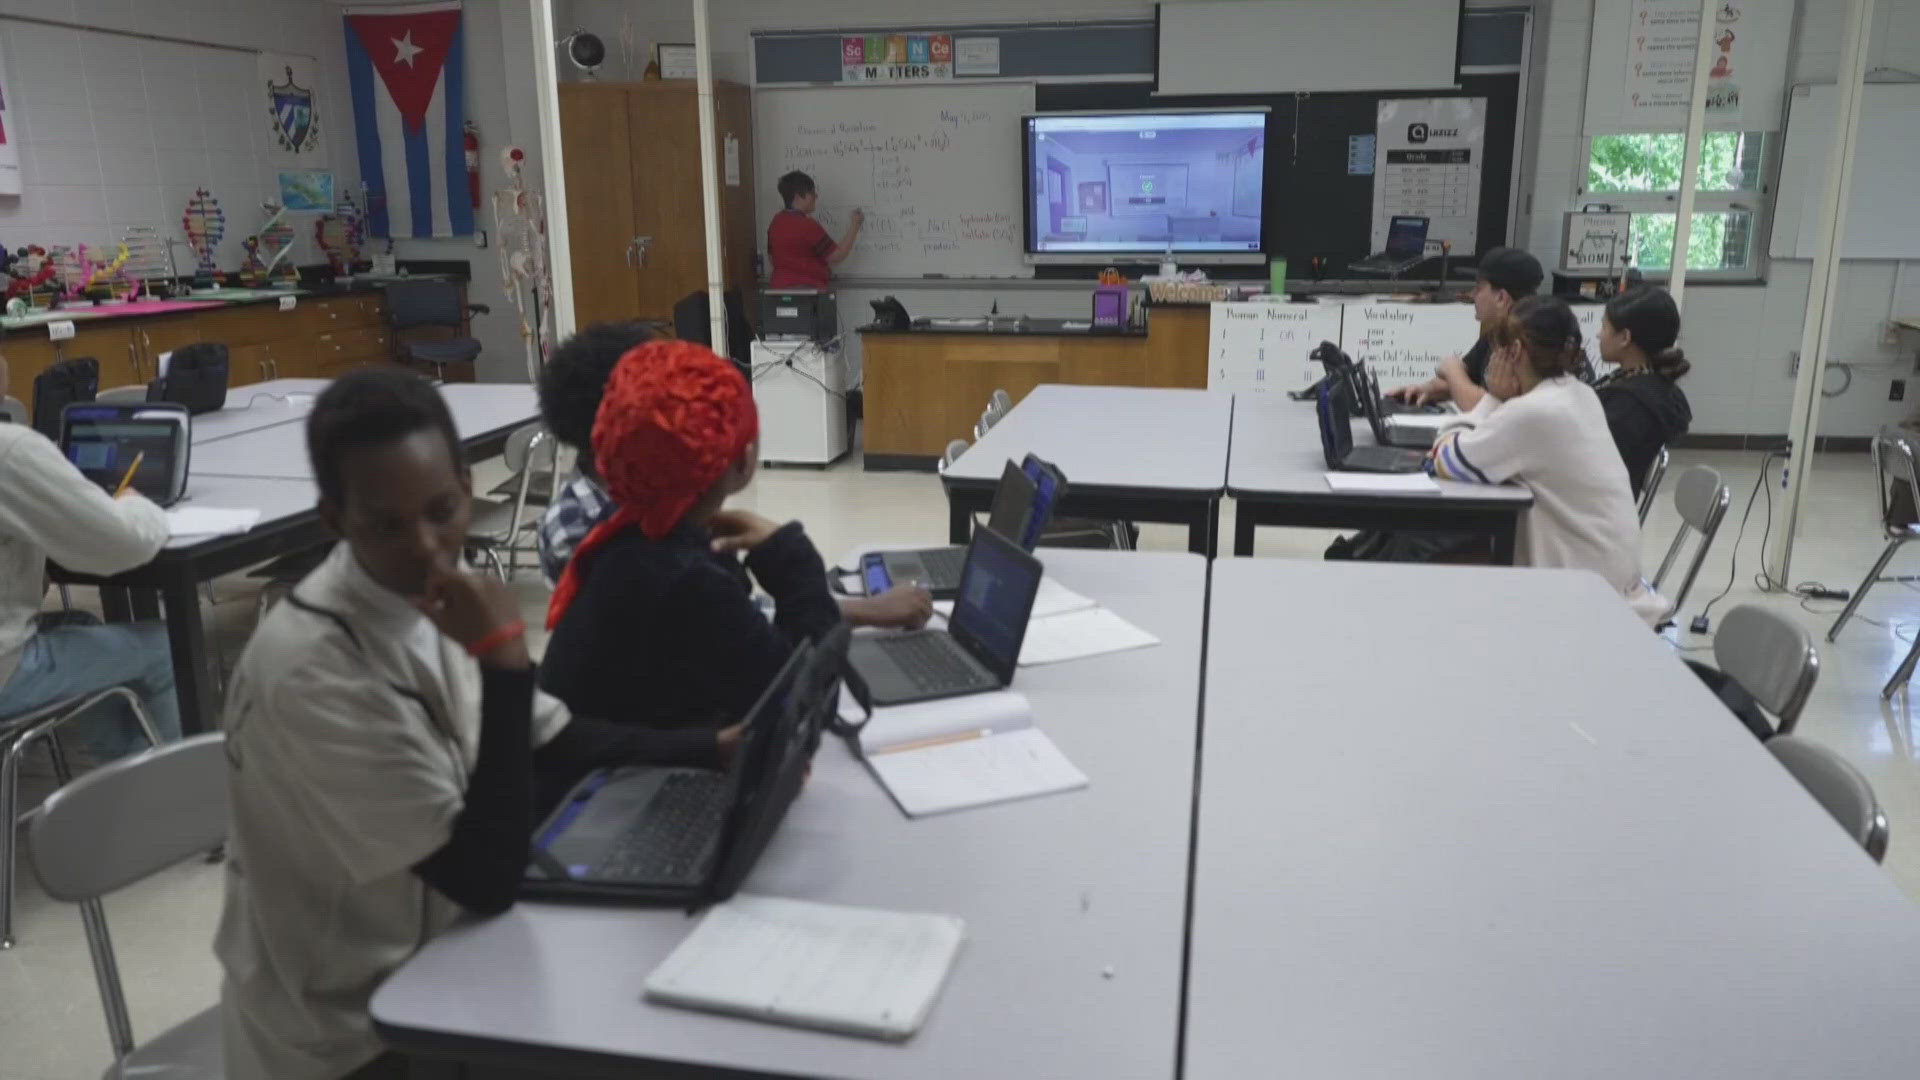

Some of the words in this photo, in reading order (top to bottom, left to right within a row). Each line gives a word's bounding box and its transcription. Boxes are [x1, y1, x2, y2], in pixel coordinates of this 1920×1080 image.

[1150, 282, 1224, 303] Welcome
[1226, 308, 1259, 320] Roman
[1266, 308, 1308, 321] Numeral
[1364, 308, 1414, 325] Vocabulary
